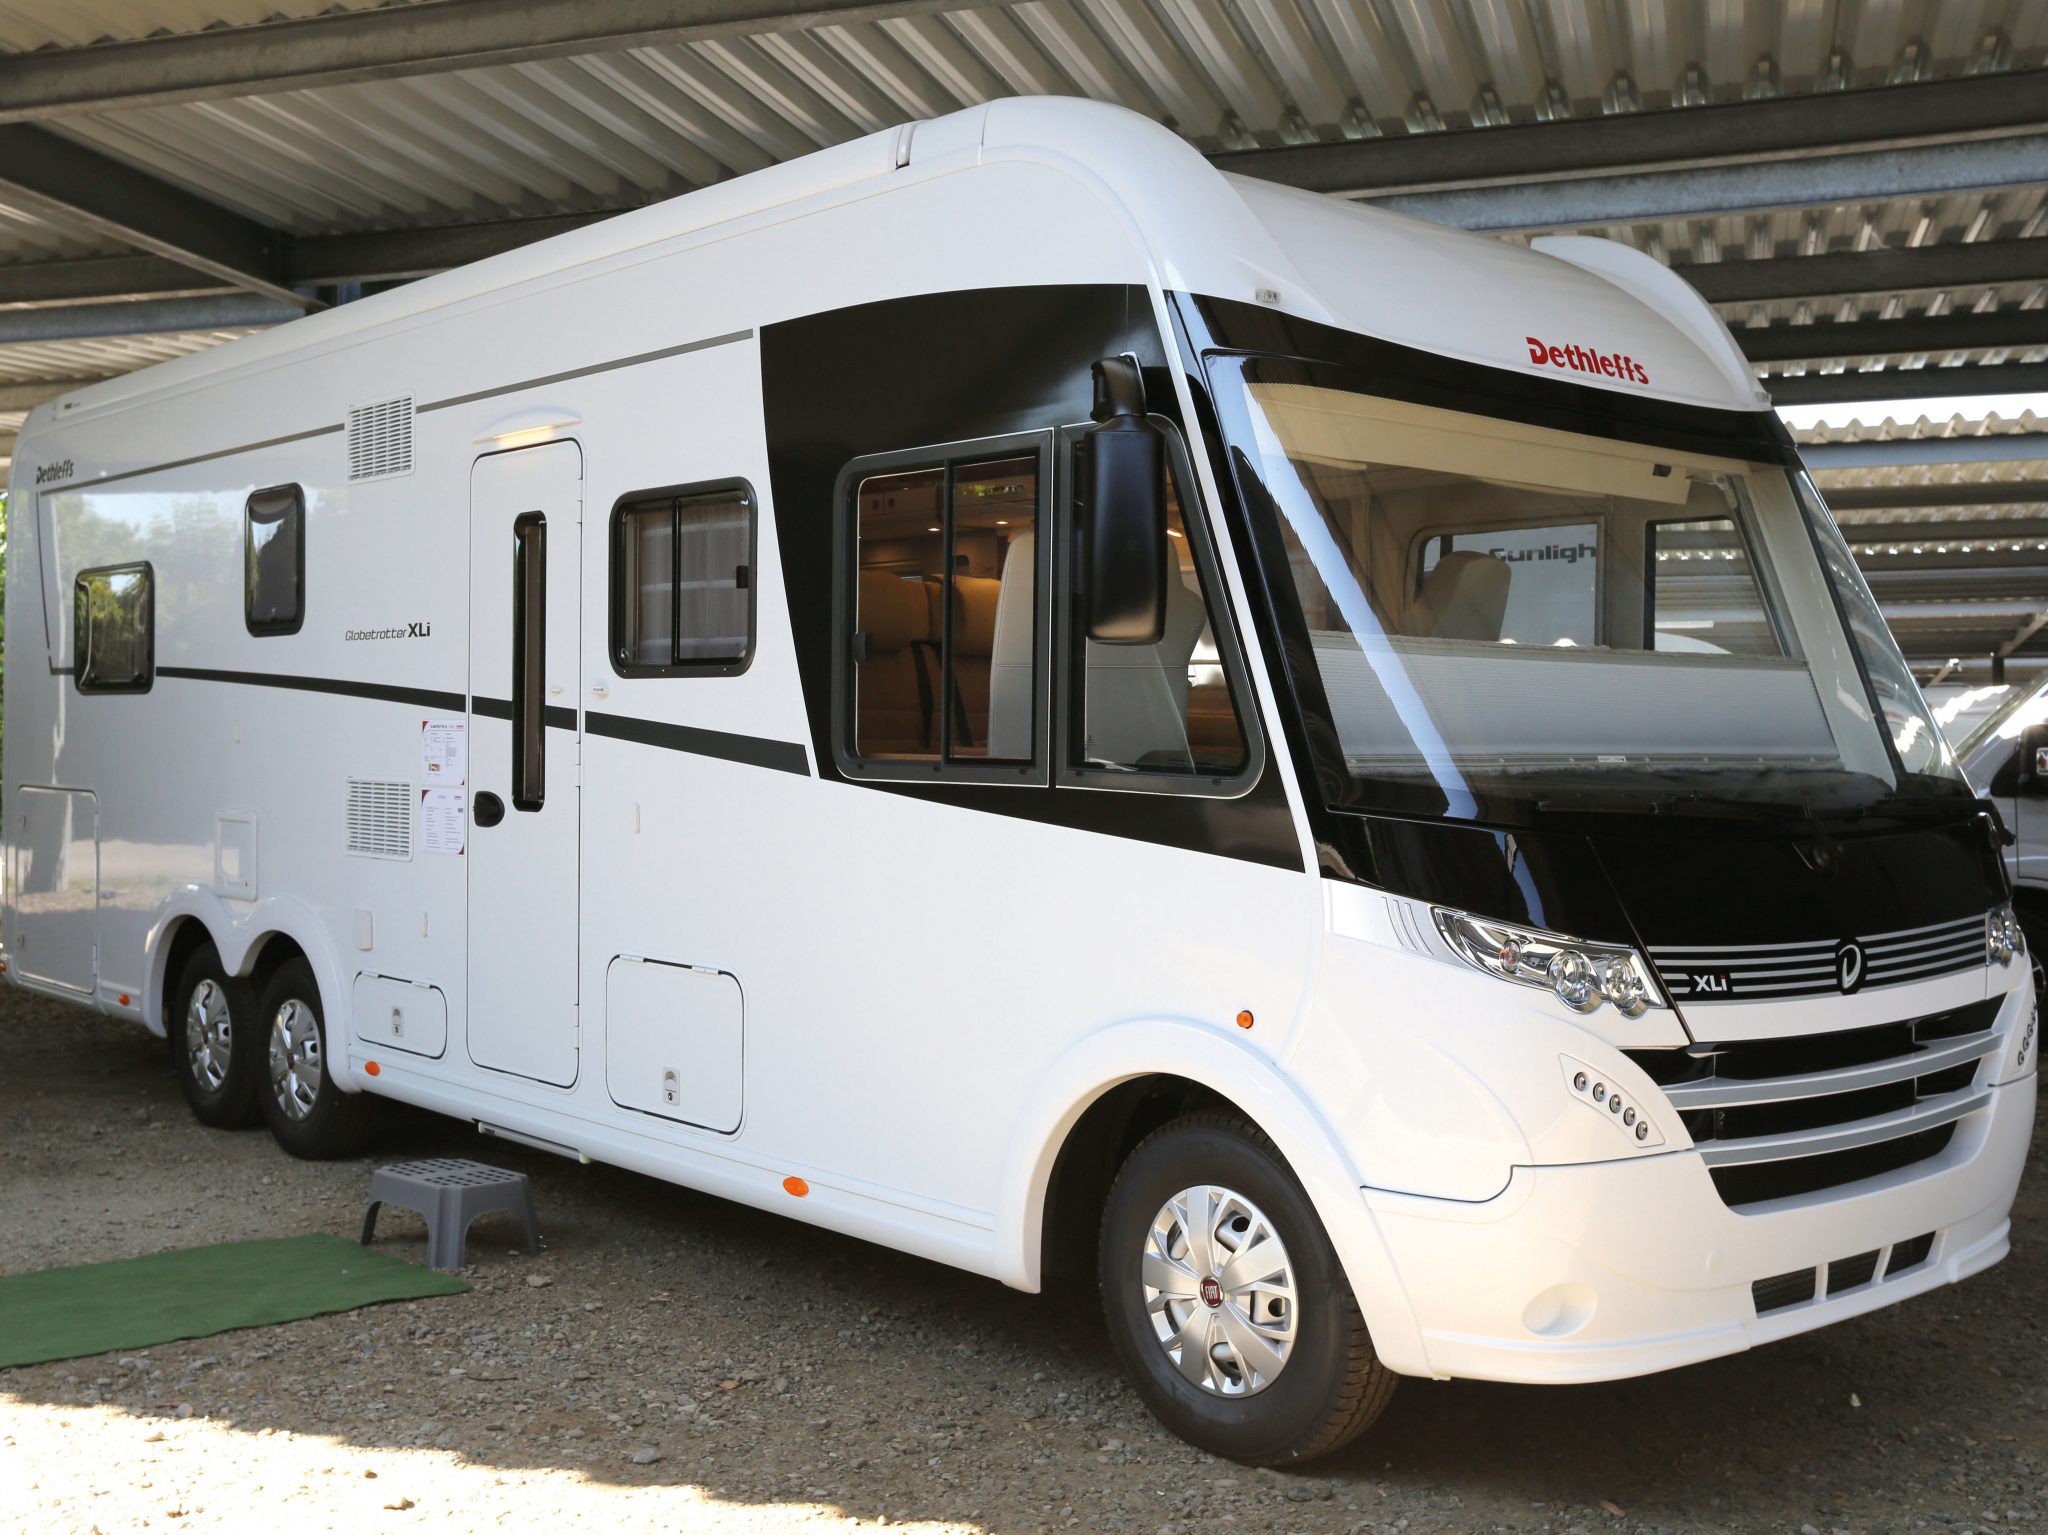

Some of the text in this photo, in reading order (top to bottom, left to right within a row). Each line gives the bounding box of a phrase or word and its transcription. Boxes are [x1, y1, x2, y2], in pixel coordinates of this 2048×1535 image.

[1526, 336, 1649, 384] Dethleffs
[345, 622, 431, 640] Globetrotter XLi
[1693, 974, 1727, 991] XLi
[1204, 1285, 1218, 1299] FIAT
